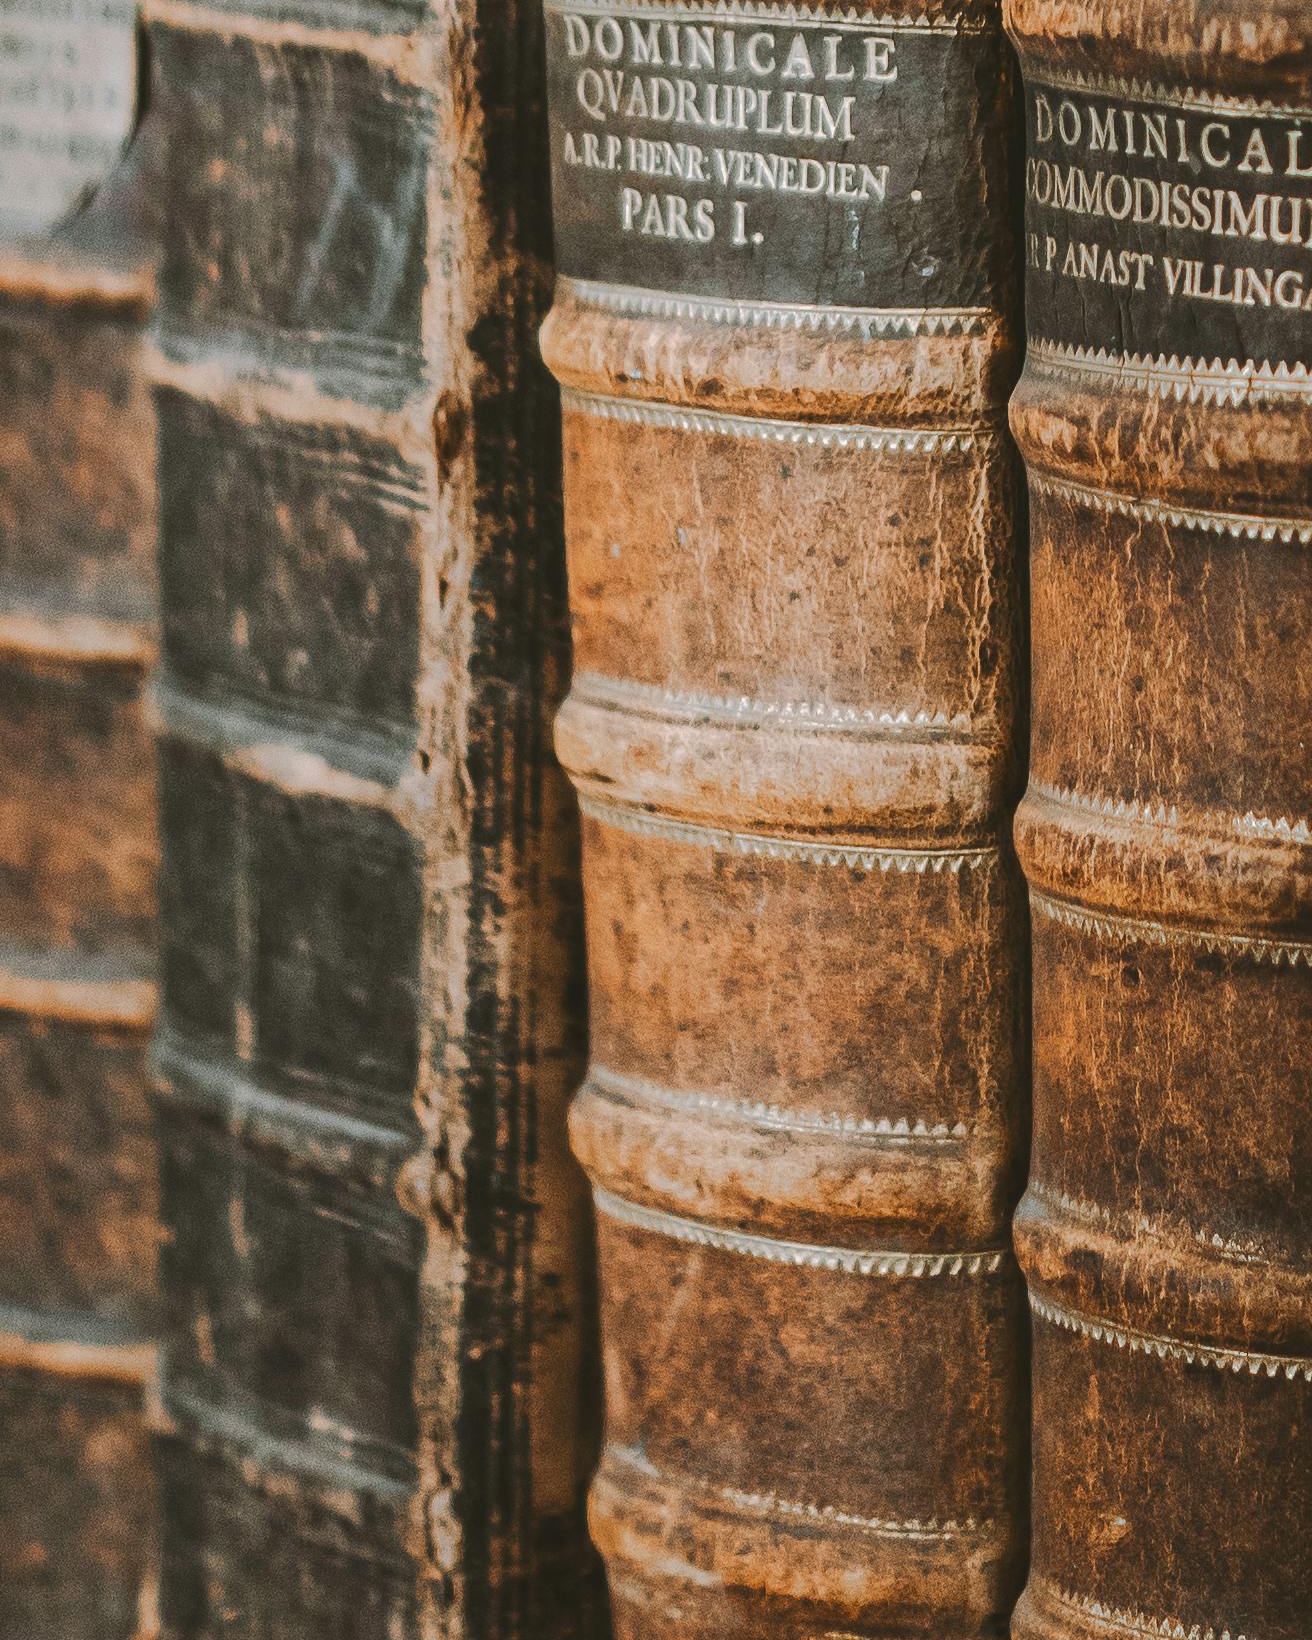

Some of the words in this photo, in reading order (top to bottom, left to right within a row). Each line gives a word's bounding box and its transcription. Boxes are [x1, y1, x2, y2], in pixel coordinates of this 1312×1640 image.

[563, 14, 898, 82] DOMINICALE
[576, 67, 857, 141] QVADRUPLUM
[621, 186, 716, 243] PARS
